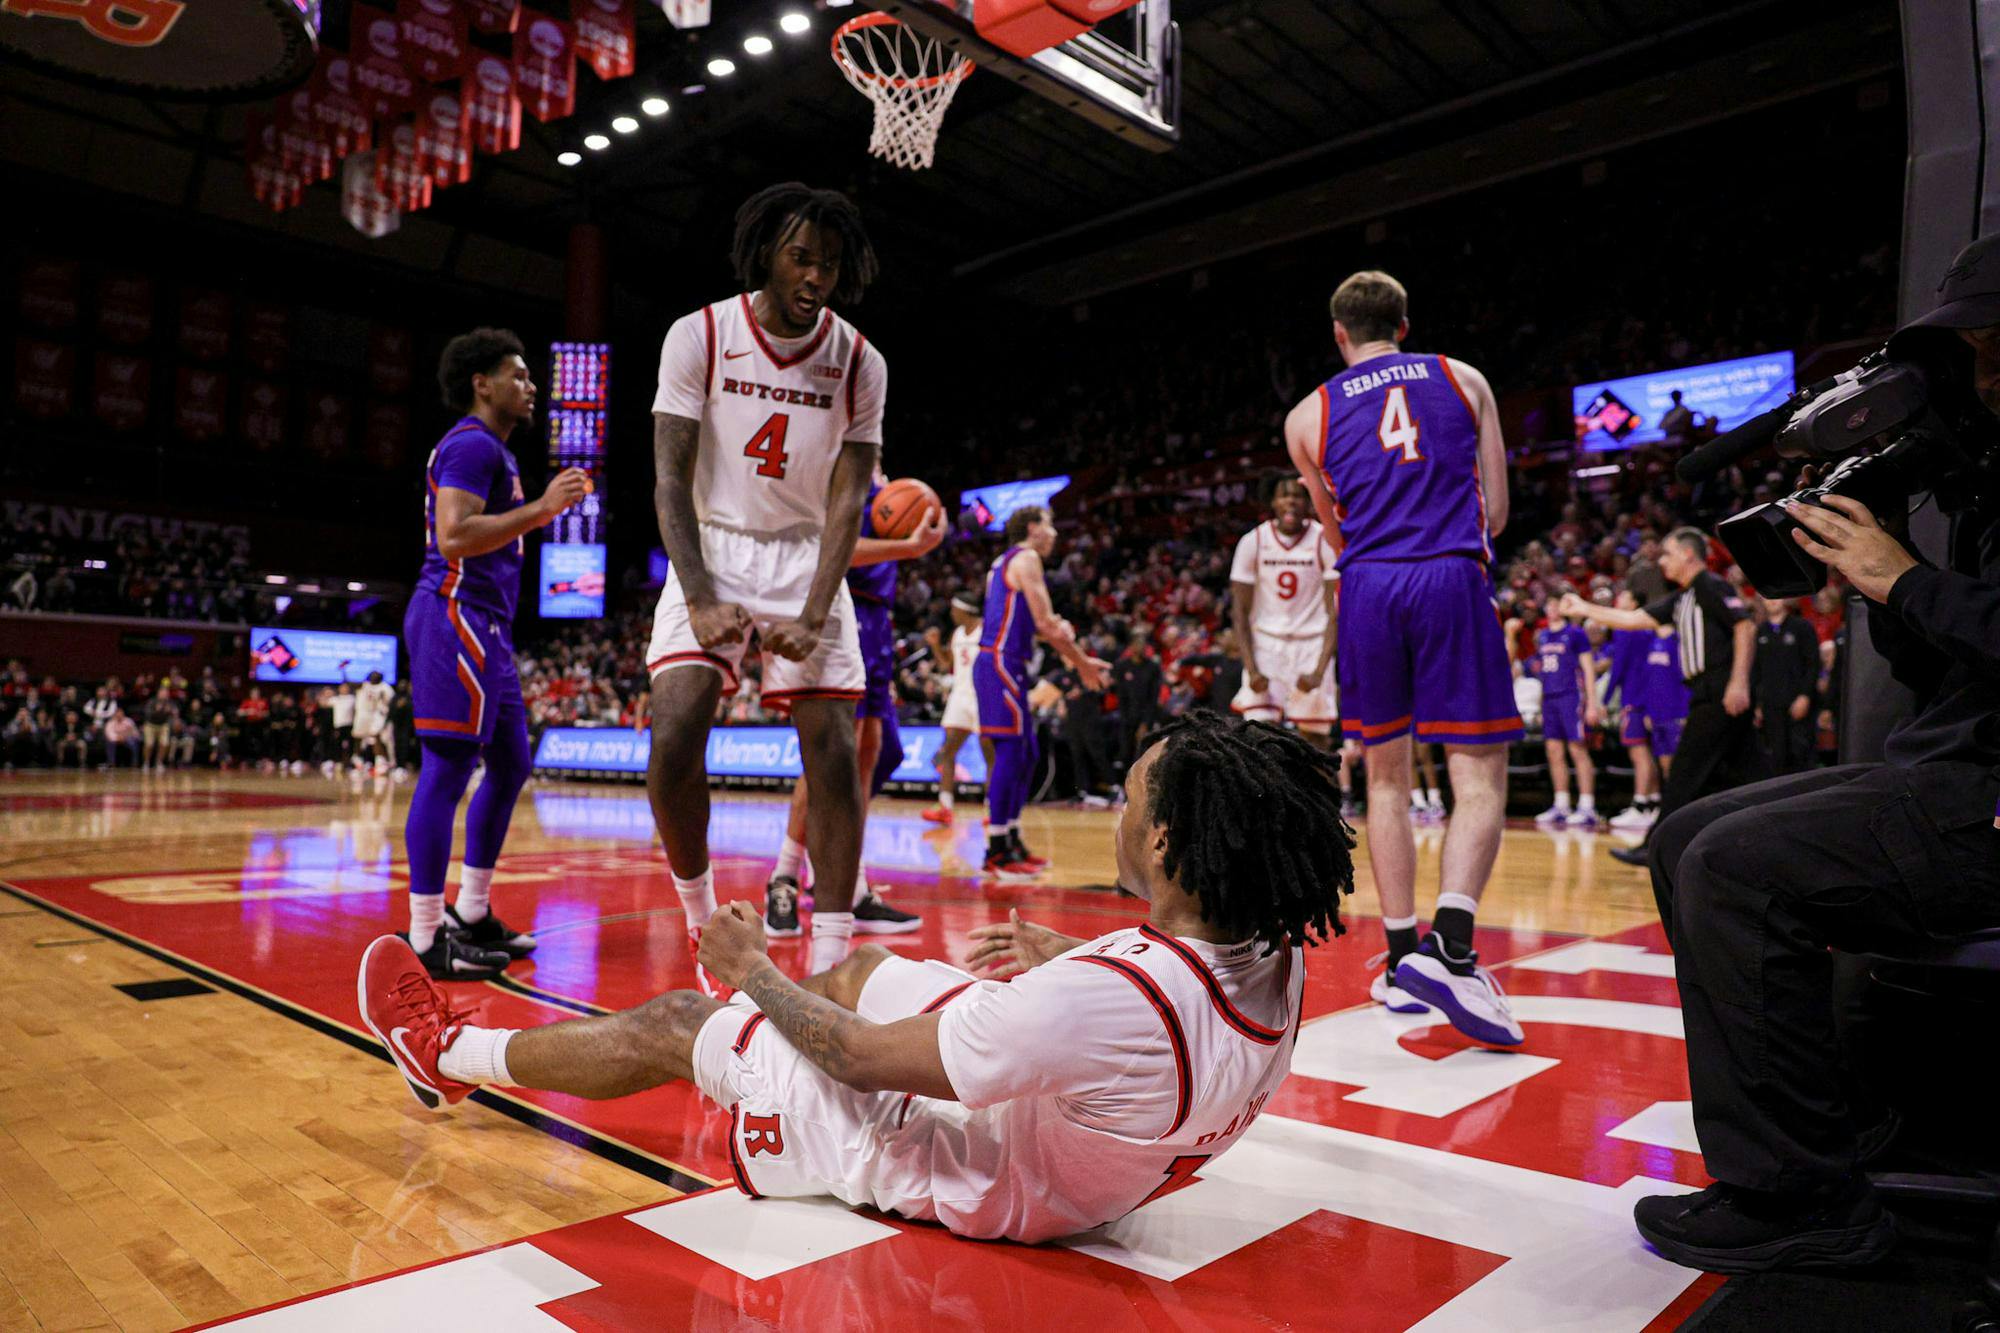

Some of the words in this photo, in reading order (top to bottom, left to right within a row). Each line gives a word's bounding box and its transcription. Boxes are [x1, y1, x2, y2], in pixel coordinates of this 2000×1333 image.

[723, 377, 833, 410] RUTGERS
[1342, 362, 1429, 398] SEBASTIAN
[1377, 384, 1425, 465] 4
[743, 412, 789, 480] 4
[1278, 570, 1298, 600] 9
[544, 732, 589, 762] Score
[590, 740, 632, 763] more
[713, 735, 780, 766] Venmo
[743, 1111, 784, 1158] R
